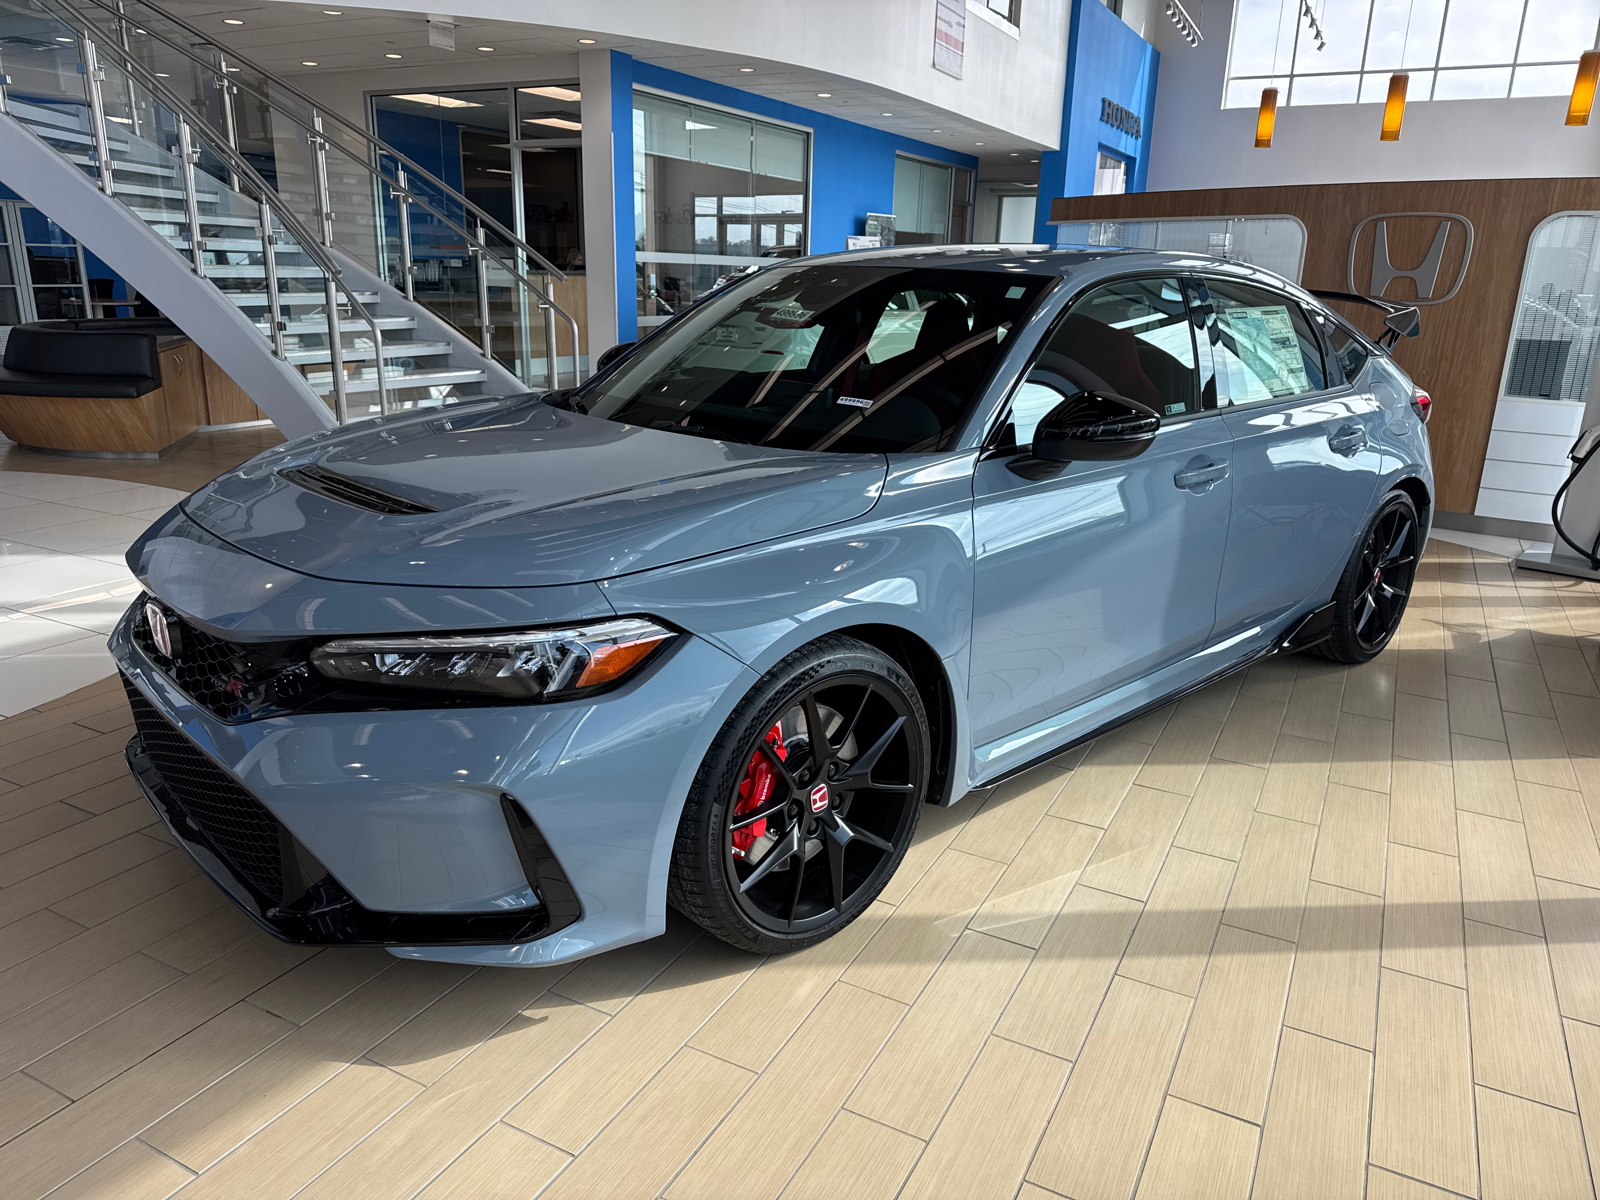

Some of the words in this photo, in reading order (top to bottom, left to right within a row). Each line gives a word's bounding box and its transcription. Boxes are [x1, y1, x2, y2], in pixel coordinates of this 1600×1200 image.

[1100, 97, 1142, 140] HONDA
[760, 773, 772, 801] brembo
[710, 858, 720, 881] PILOT
